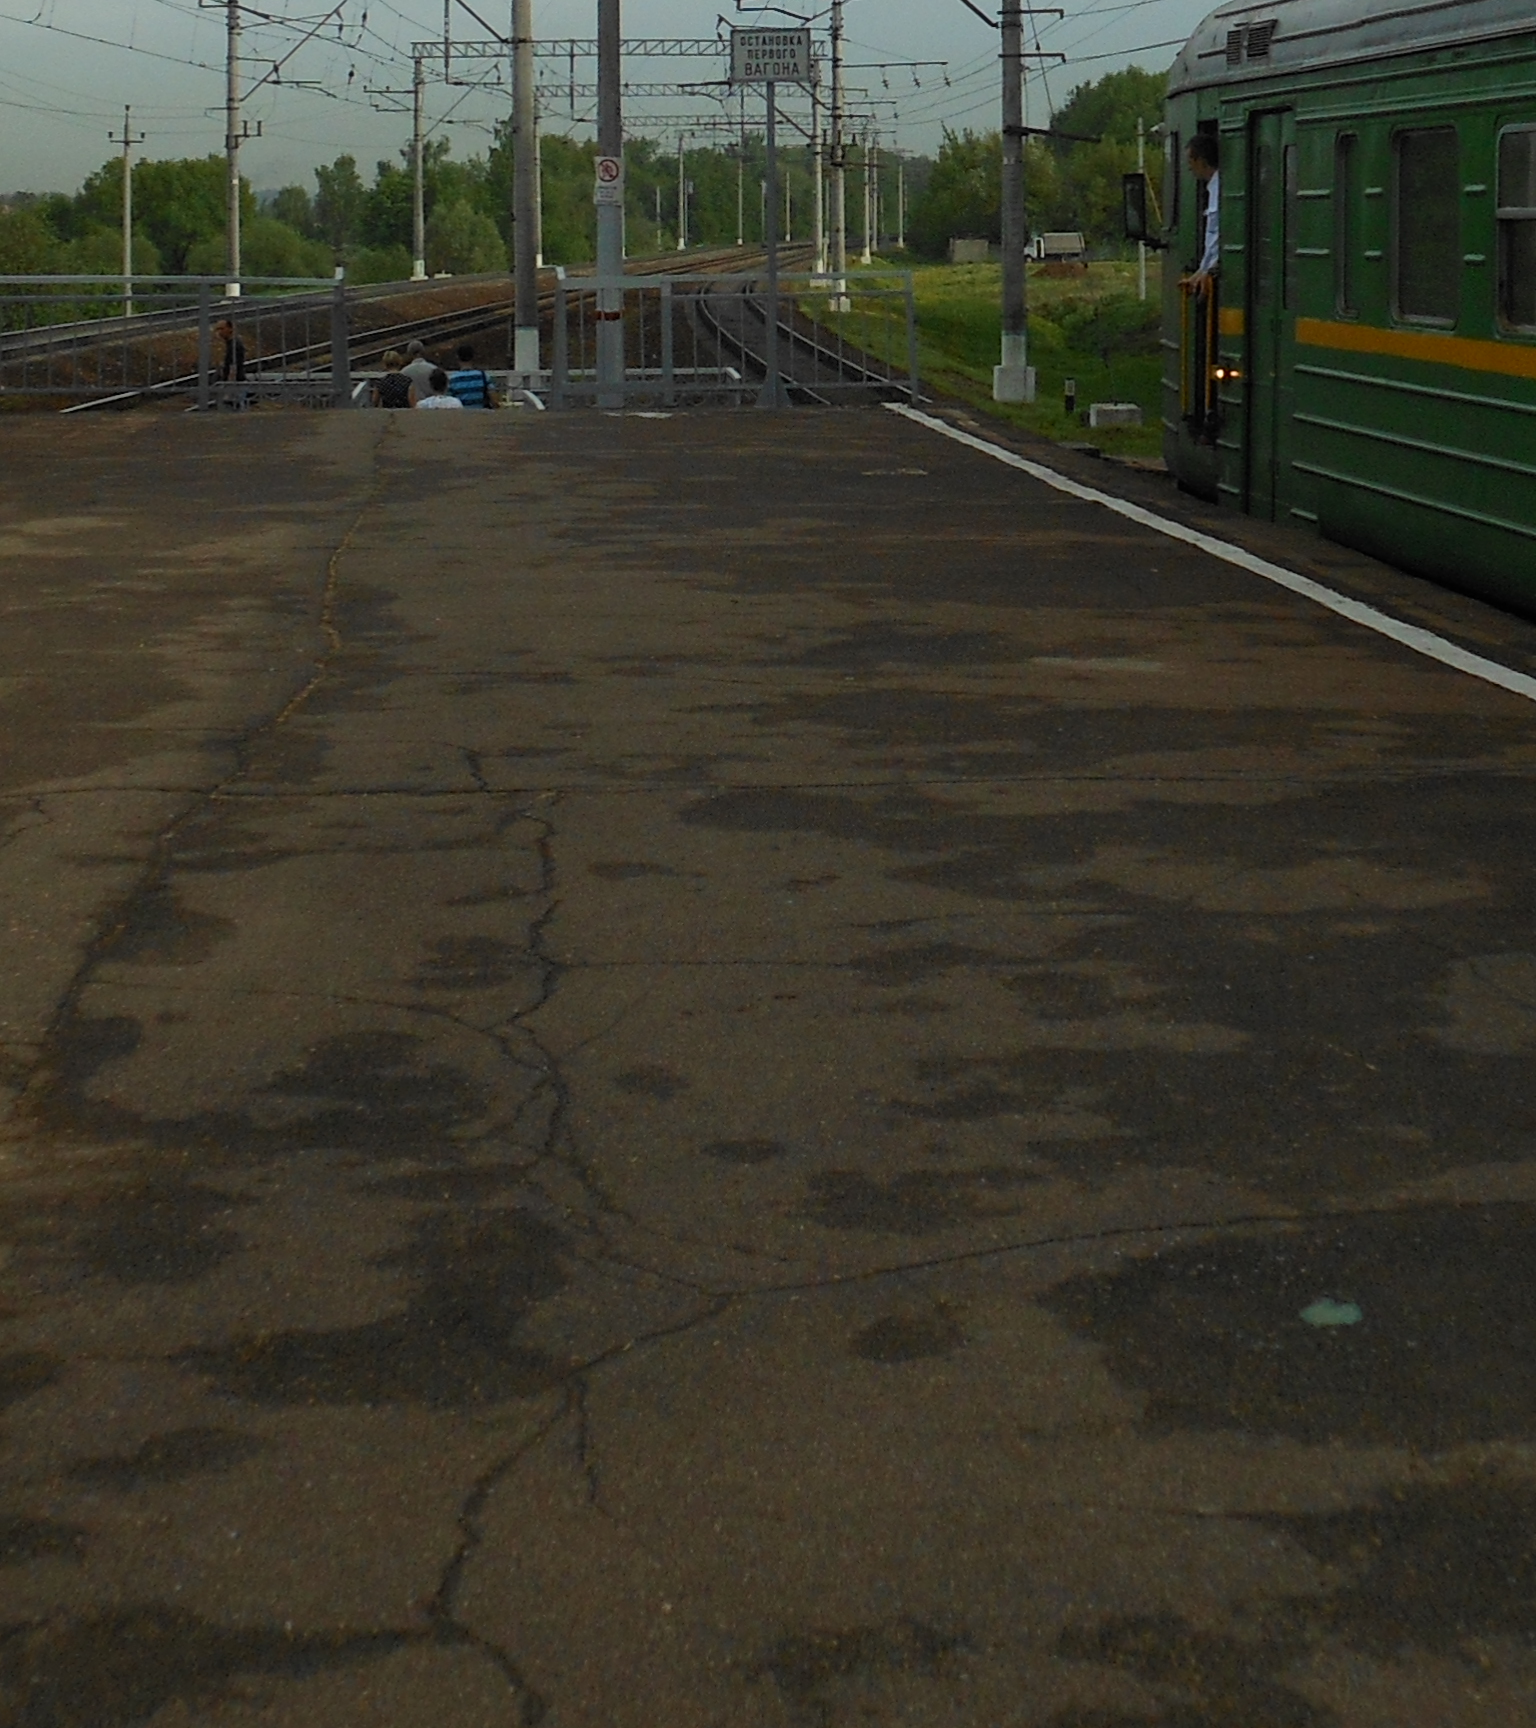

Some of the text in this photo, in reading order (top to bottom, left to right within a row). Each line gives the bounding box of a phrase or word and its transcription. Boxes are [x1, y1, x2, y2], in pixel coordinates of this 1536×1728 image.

[739, 35, 803, 47] ОСТАНОВКА
[747, 48, 796, 60] ПЕРВОГО
[744, 62, 800, 76] ВАГОНА
